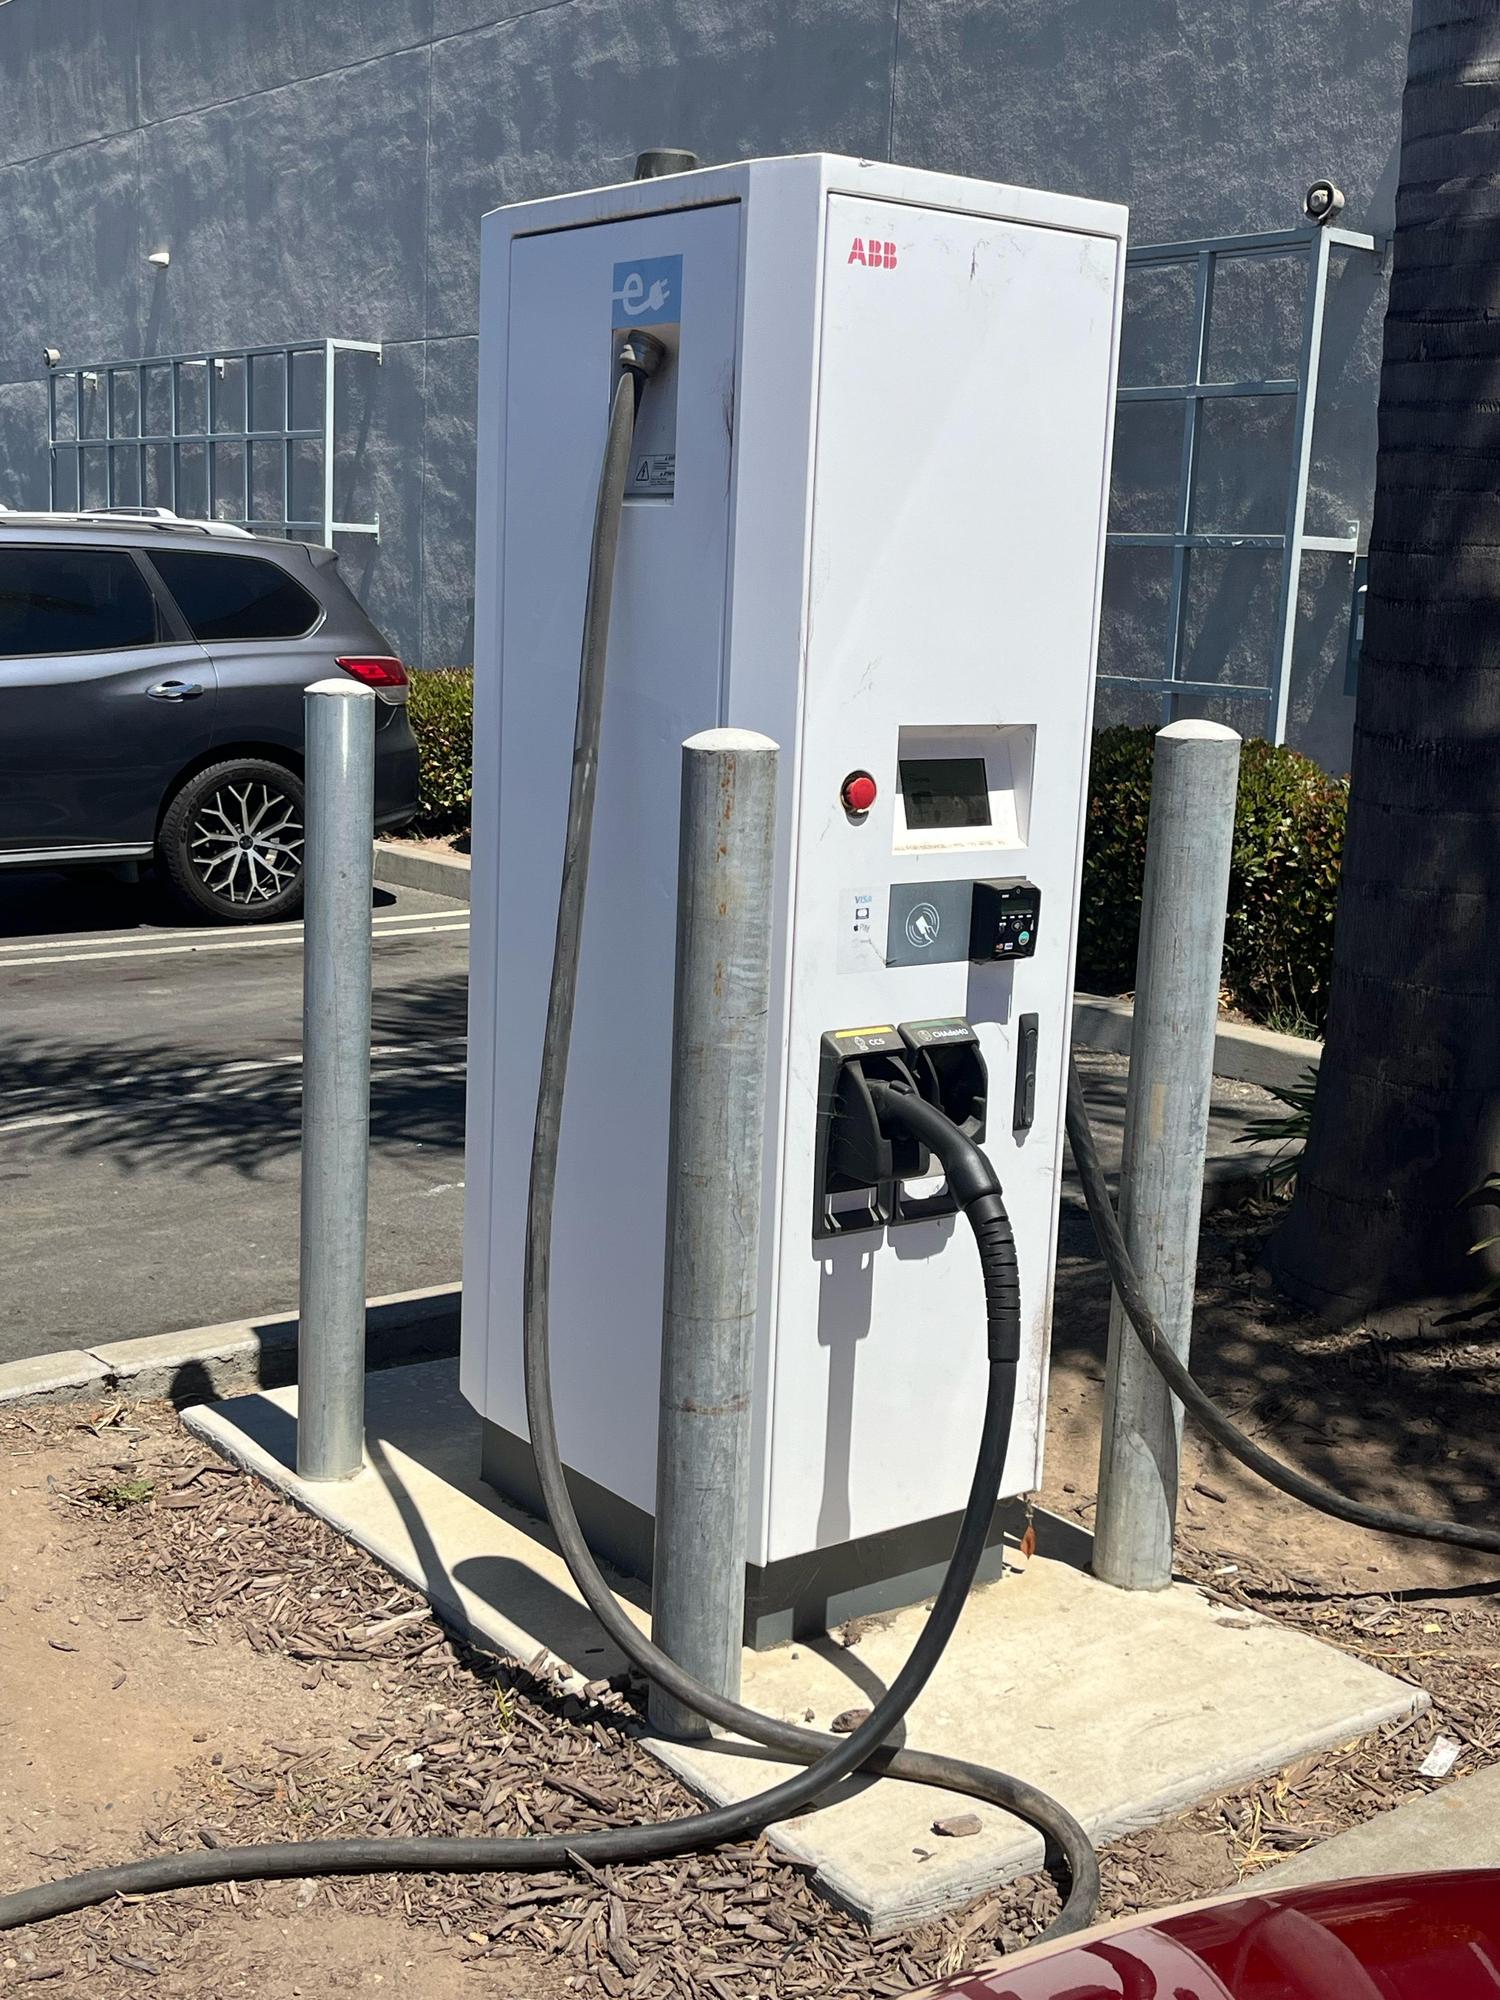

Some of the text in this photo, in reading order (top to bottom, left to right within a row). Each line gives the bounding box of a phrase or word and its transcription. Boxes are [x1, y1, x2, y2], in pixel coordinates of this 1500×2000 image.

[847, 237, 897, 269] ABB
[854, 895, 872, 904] VISA
[868, 1038, 885, 1046] CCS
